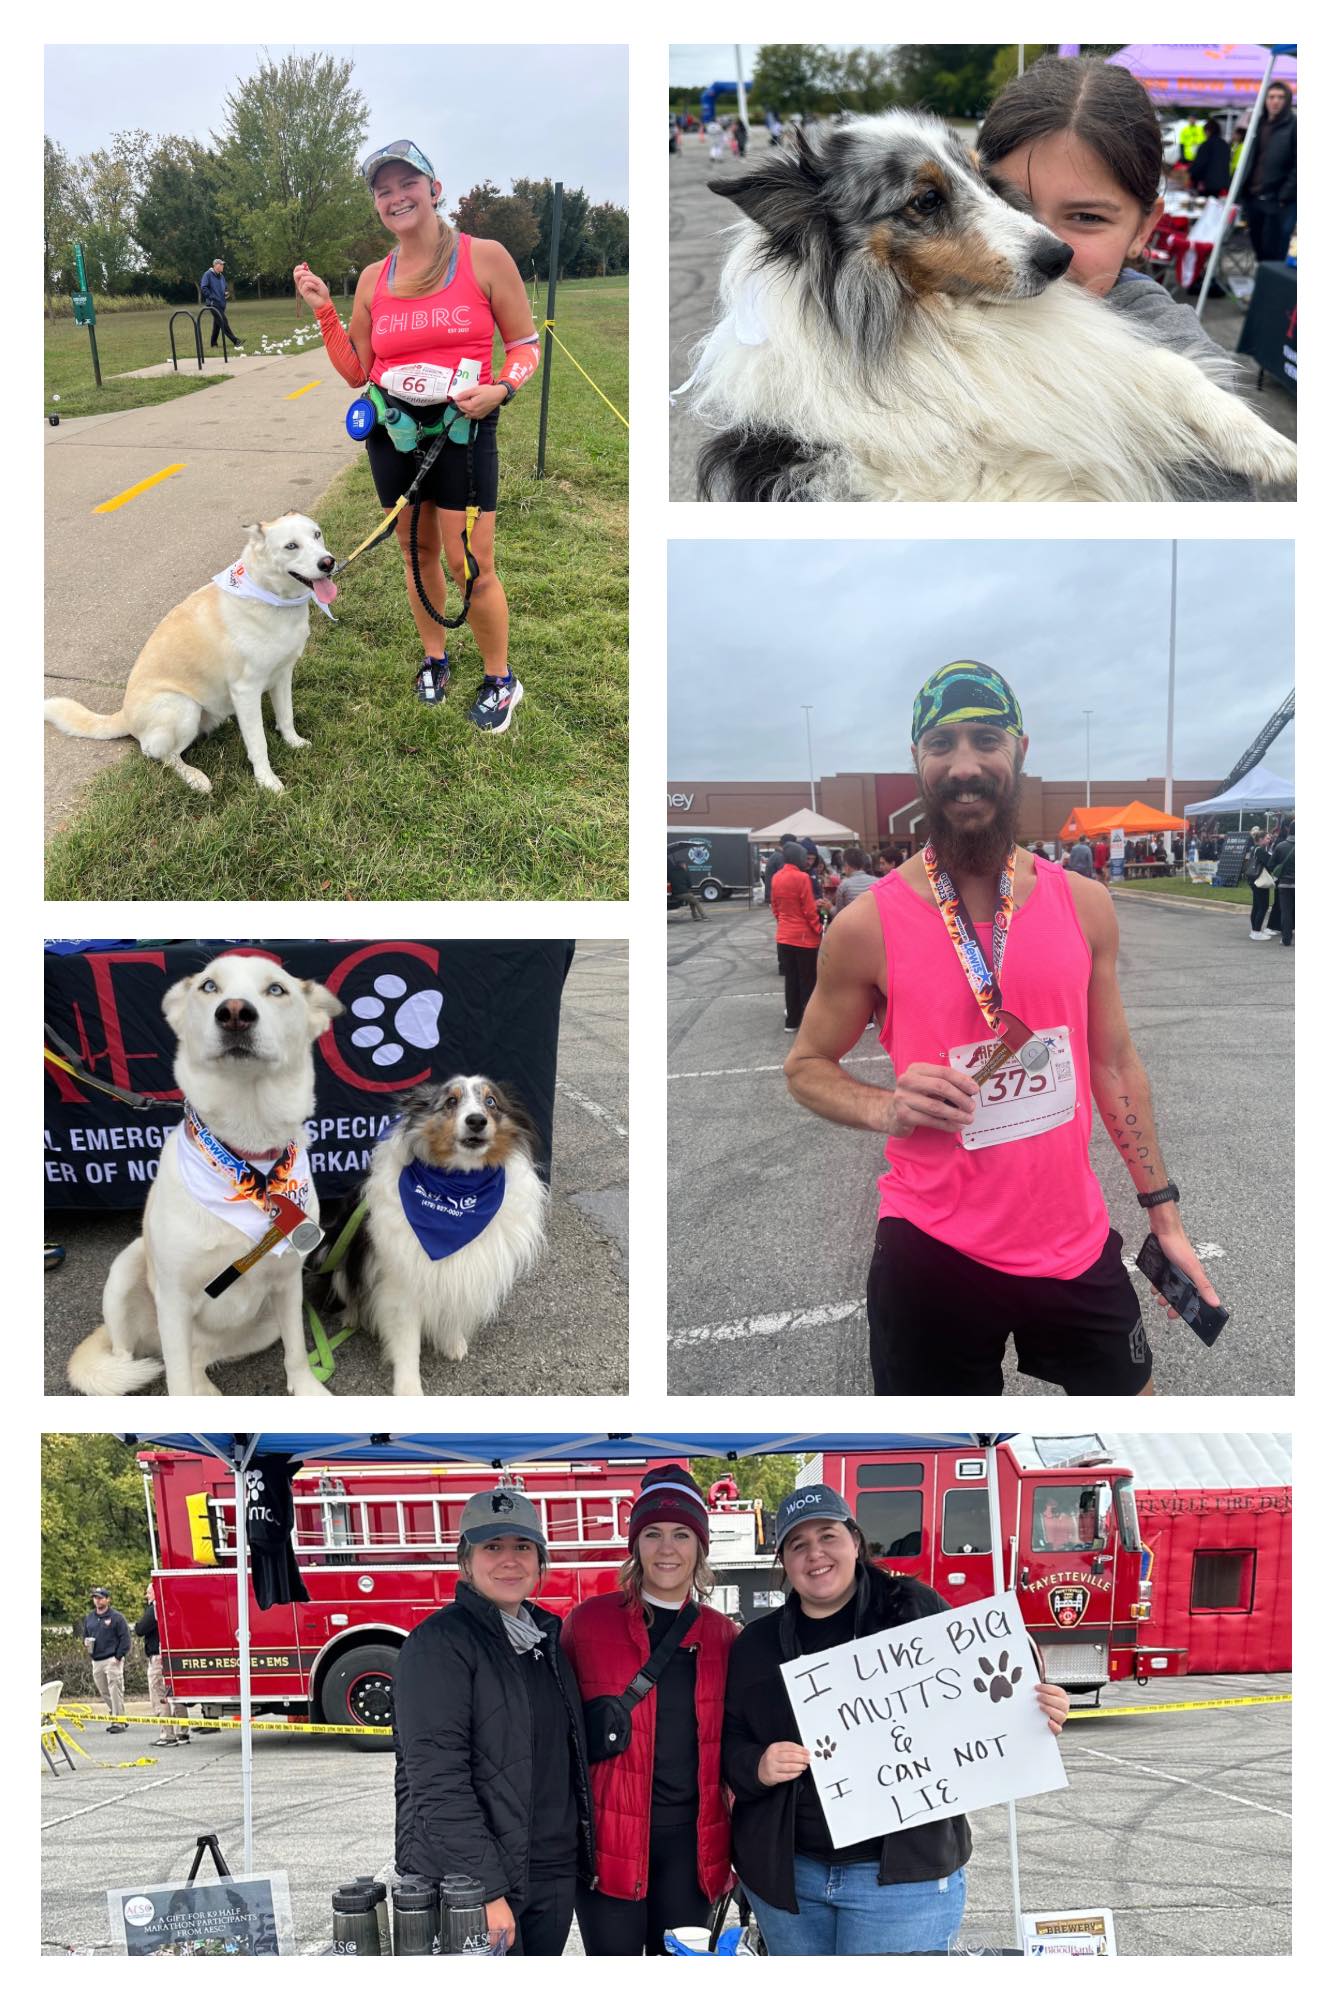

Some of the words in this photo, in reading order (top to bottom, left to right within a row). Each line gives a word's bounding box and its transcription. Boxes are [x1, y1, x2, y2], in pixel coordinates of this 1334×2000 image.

[376, 305, 472, 334] CHBRC
[402, 377, 427, 393] 66
[963, 940, 982, 975] Lewis
[987, 1068, 1047, 1102] 375
[304, 1114, 400, 1142] SPECIA
[199, 1127, 230, 1165] Lewis
[85, 1161, 118, 1184] OF
[786, 1494, 822, 1516] WOOF
[1028, 1572, 1112, 1593] FAYETTEVILLE
[181, 1658, 208, 1669] FIRE
[215, 1657, 258, 1668] RESCE
[266, 1656, 290, 1667] EMS
[795, 1662, 832, 1703] I
[853, 1636, 934, 1681] LIKE
[946, 1610, 1011, 1655] BIG
[837, 1668, 962, 1731] MUTTS
[891, 1725, 912, 1753] &
[825, 1778, 853, 1800] I
[877, 1757, 932, 1787] CAN
[953, 1734, 1008, 1767] NOT
[891, 1778, 958, 1824] LIE
[144, 1920, 195, 1933] MARATHON
[196, 1913, 258, 1927] PARTICIPANTS
[159, 1916, 165, 1924] A
[166, 1913, 186, 1923] GIFT
[188, 1911, 206, 1921] FOR
[207, 1910, 217, 1918] K9
[218, 1907, 241, 1916] HALF
[1046, 1921, 1096, 1934] BREWERY
[176, 1927, 202, 1937] FROM
